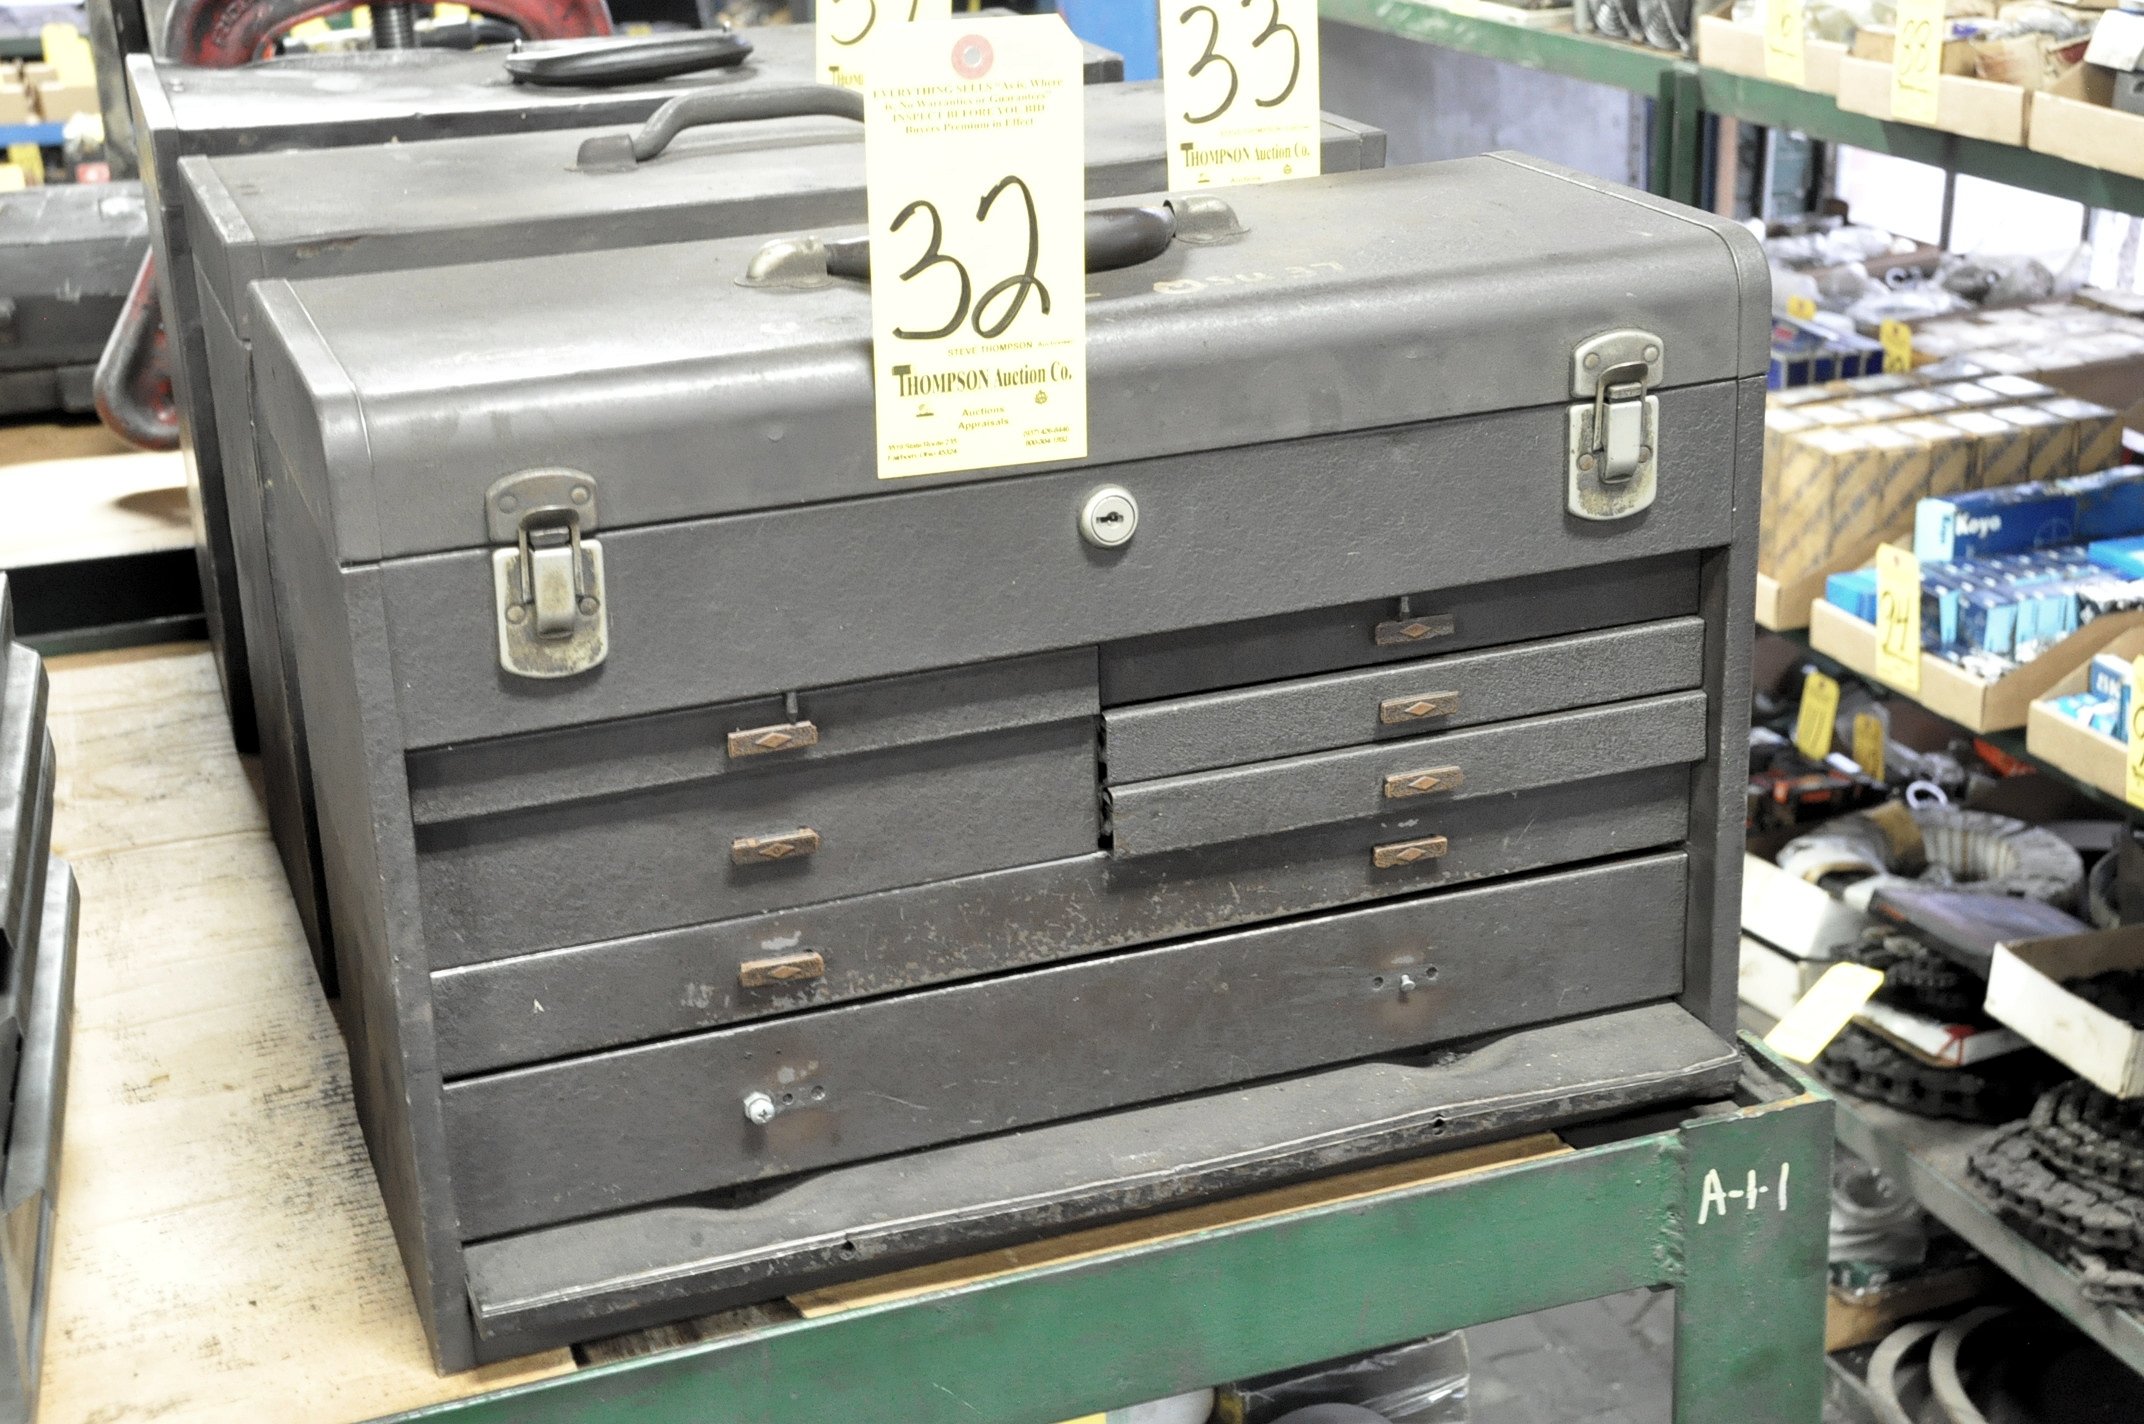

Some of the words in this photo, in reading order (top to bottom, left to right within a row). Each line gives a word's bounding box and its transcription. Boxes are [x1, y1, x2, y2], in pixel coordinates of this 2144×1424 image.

[1180, 0, 1300, 124] 33
[873, 85, 952, 98] EVERYTHING
[893, 111, 942, 123] INSPECT
[946, 107, 993, 119] BEFORE
[943, 122, 990, 132] Premium
[1180, 142, 1250, 168] THOMPSON
[1255, 145, 1291, 161] Auction
[1294, 142, 1310, 158] Co.
[889, 175, 1051, 340] 32
[948, 347, 976, 357] STEVE
[981, 341, 1033, 352] THOMPSON
[892, 365, 989, 397] THOMPSON
[995, 364, 1046, 388] Auction
[1050, 361, 1073, 382] Co.
[961, 406, 1006, 417] Auctions
[958, 418, 1009, 431] Appraisals
[1697, 1161, 1790, 1225] A-1-1
